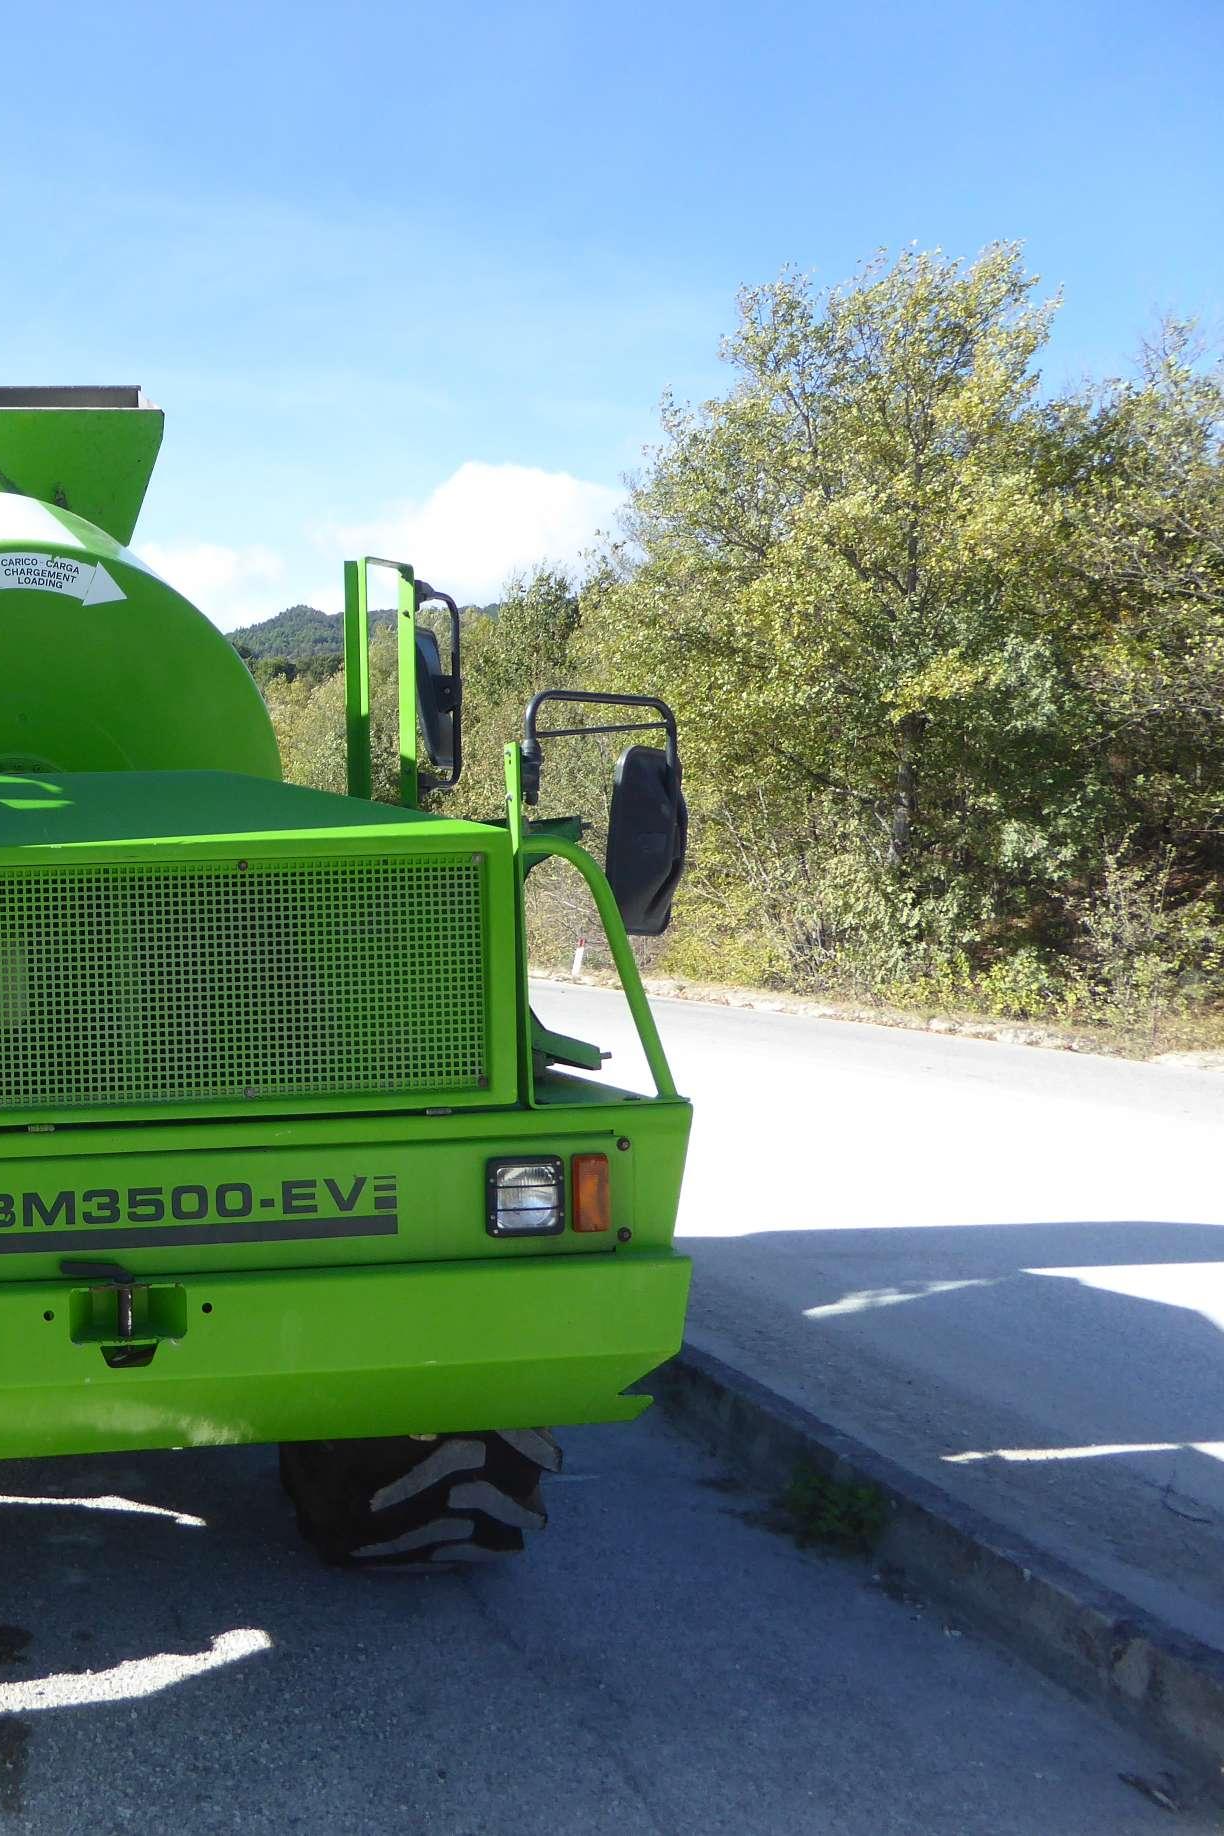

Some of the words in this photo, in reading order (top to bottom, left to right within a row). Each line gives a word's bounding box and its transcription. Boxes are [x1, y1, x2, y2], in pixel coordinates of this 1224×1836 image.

[0, 558, 38, 566] CARICO
[45, 560, 80, 575] CARGA
[4, 568, 77, 583] CHARGEMENT
[17, 577, 63, 589] LOADING
